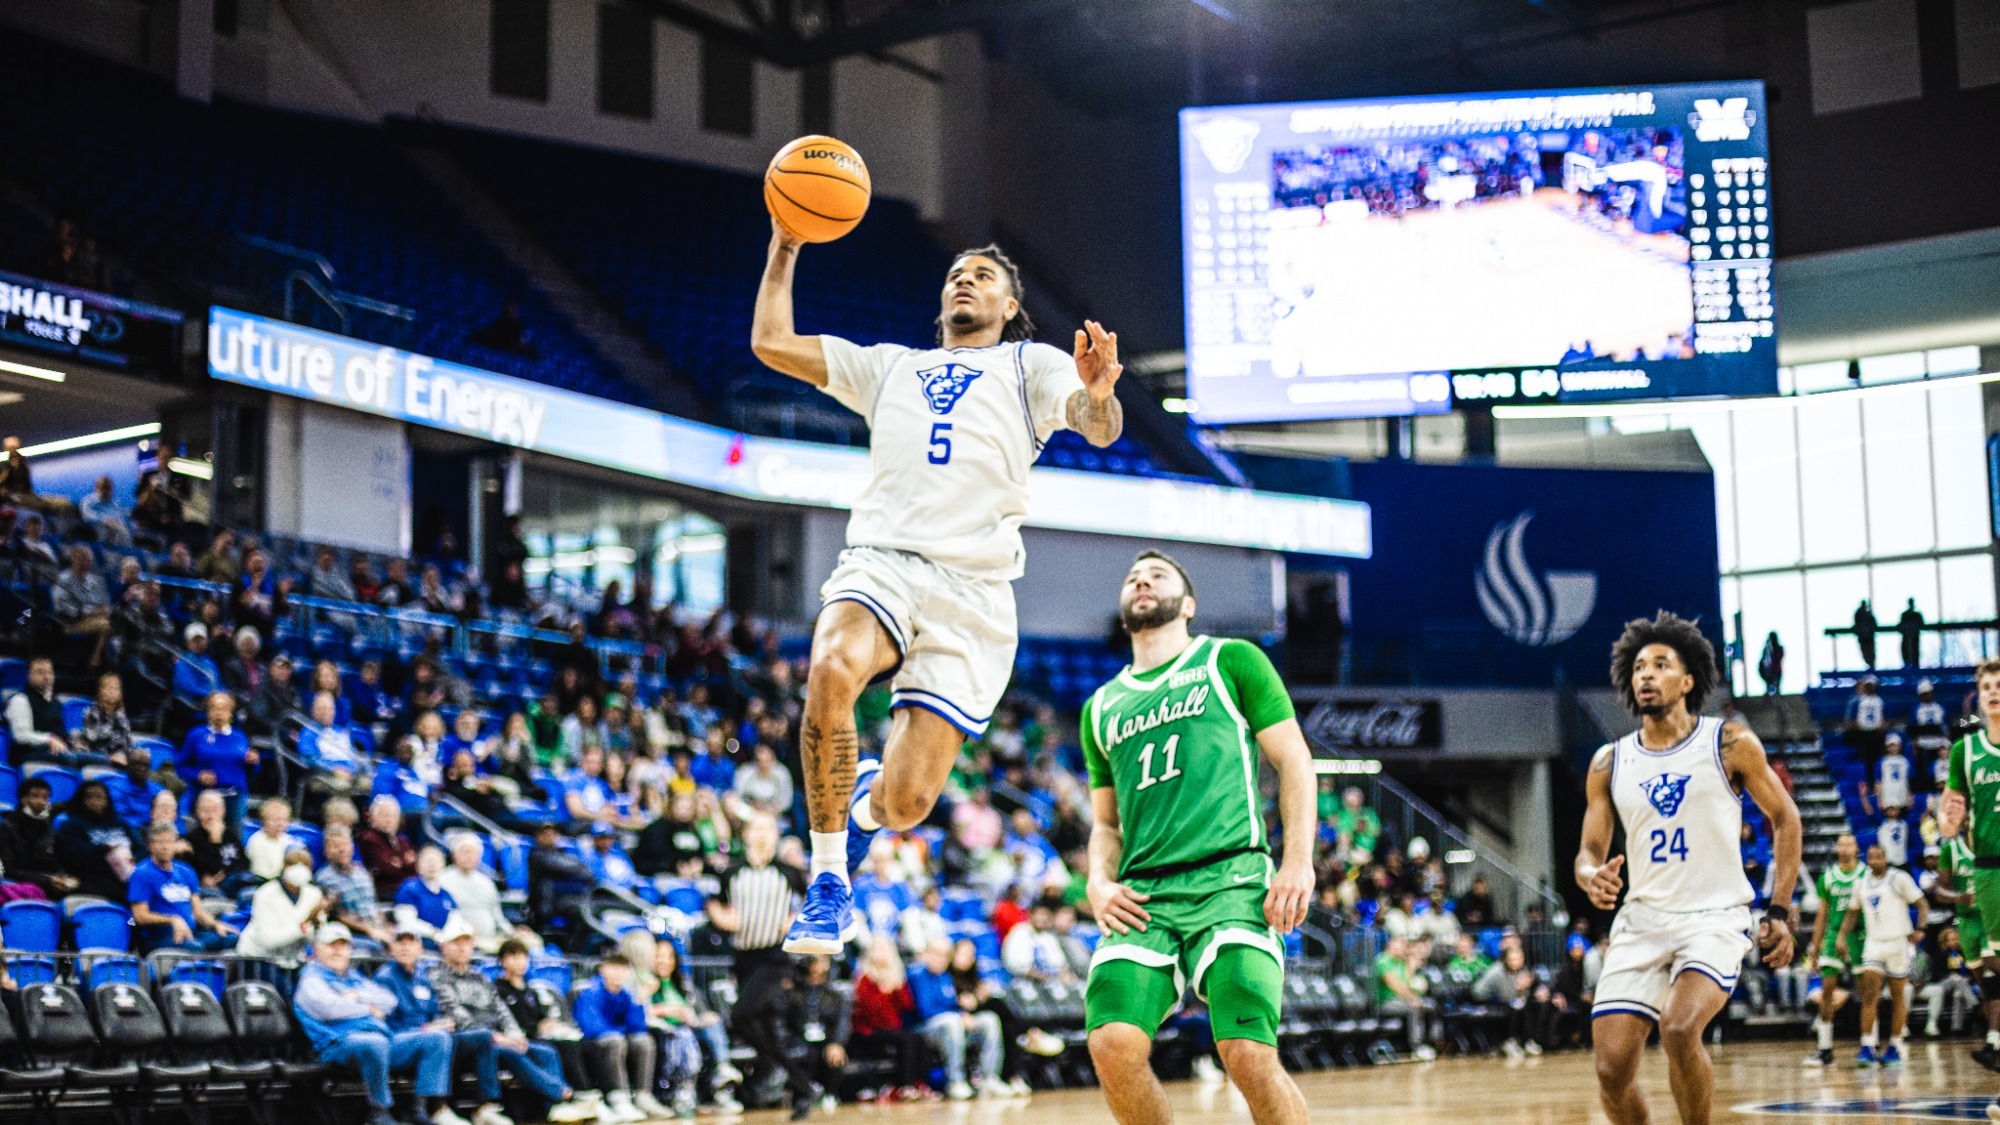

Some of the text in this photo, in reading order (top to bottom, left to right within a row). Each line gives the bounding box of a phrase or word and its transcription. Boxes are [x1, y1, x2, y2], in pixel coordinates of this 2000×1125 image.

[209, 319, 545, 449] uture of Energy
[927, 422, 953, 466] 5
[1105, 684, 1210, 752] Marshall
[1135, 733, 1182, 791] 11
[1650, 826, 1690, 863] 24
